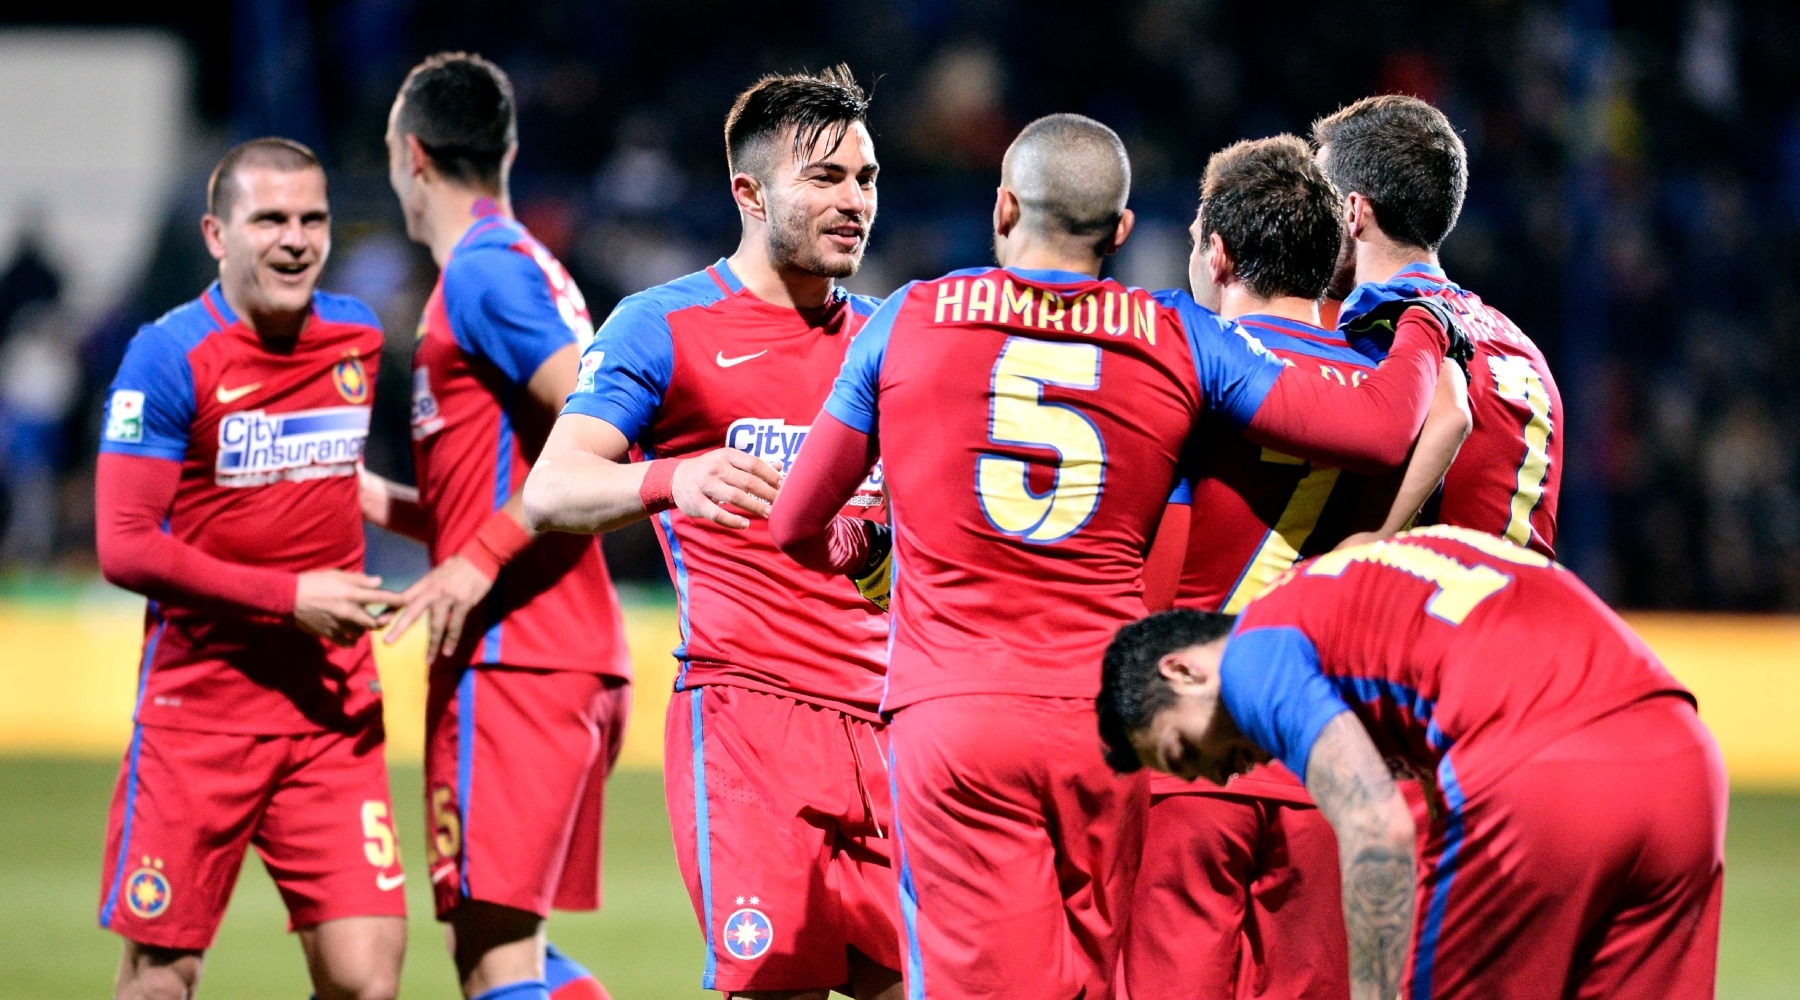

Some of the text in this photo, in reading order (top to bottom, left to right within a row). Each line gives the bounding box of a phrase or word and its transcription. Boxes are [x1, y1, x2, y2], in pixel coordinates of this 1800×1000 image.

[934, 278, 1156, 345] HAMROUN
[222, 416, 280, 448] City
[243, 435, 367, 467] Insuranc
[728, 424, 799, 462] City
[975, 335, 1108, 545] 5
